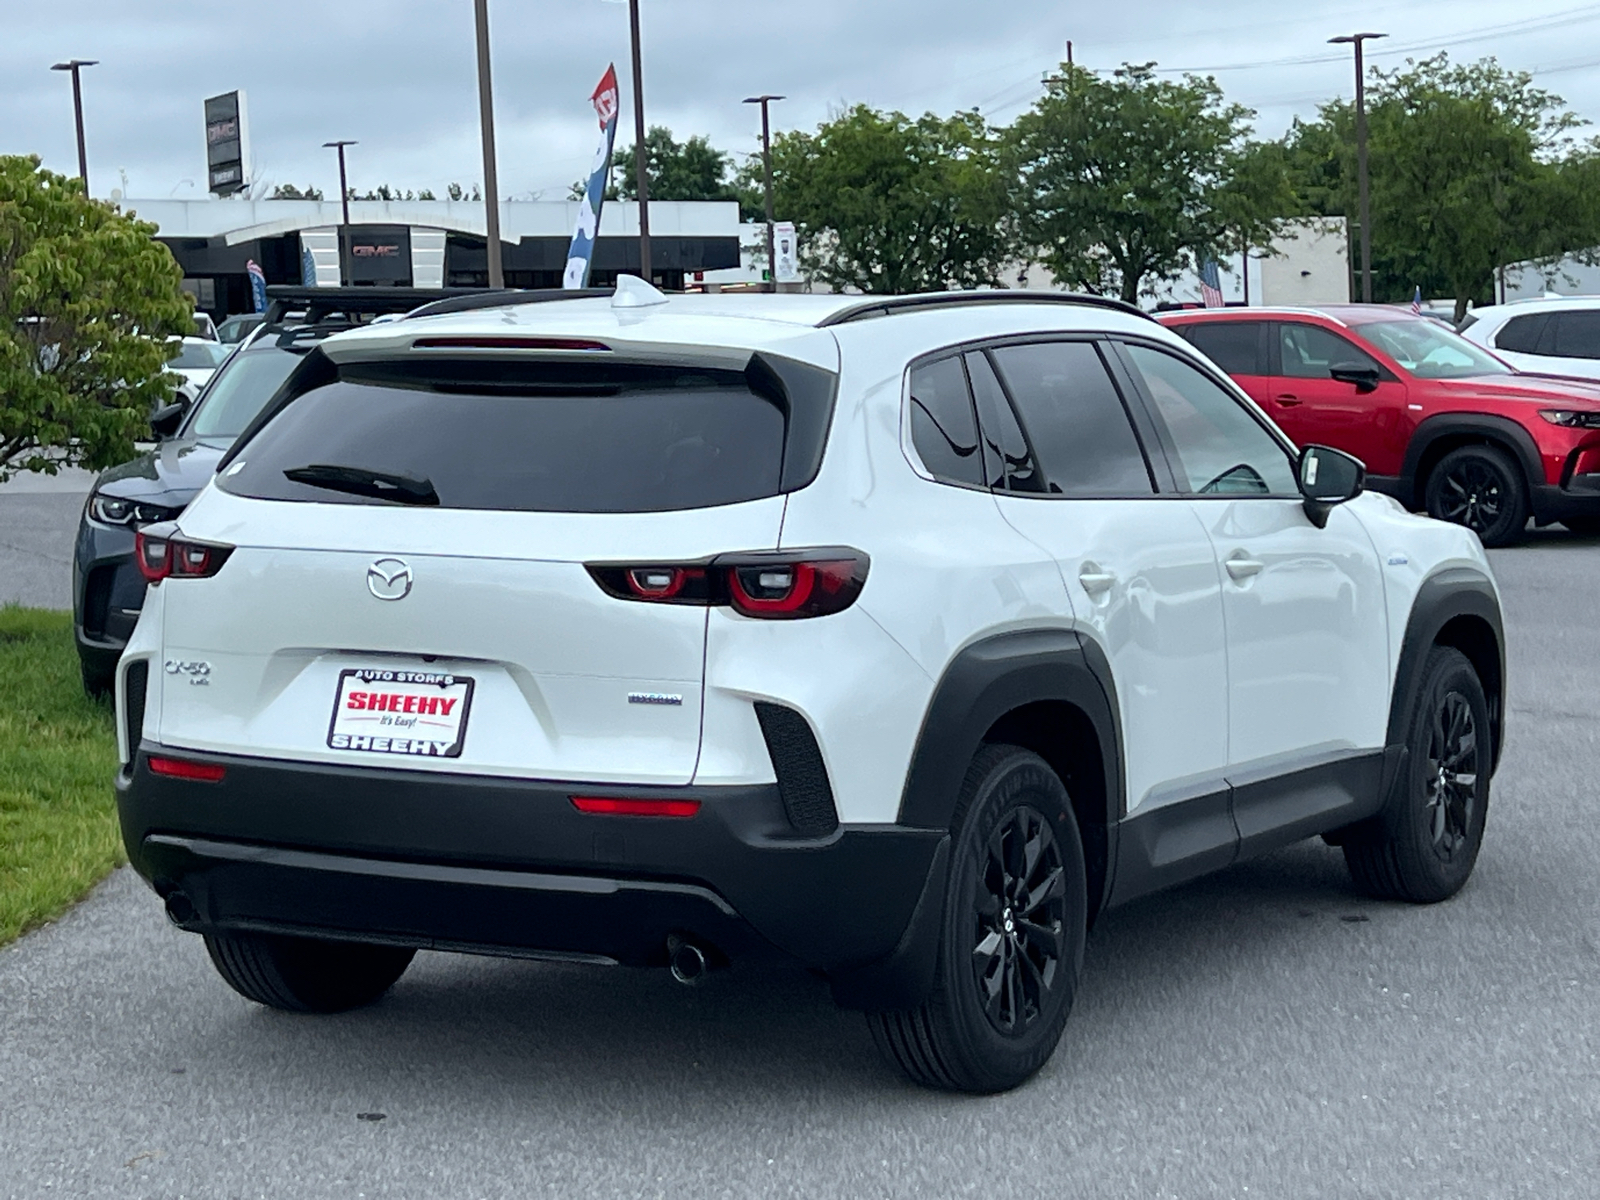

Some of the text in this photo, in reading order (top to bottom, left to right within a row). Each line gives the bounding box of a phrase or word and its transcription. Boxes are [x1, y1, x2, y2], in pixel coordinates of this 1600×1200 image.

[352, 245, 399, 257] GMC
[165, 659, 211, 675] CX-50
[355, 670, 454, 685] AUTO STORES
[347, 691, 458, 716] SHEEHY
[394, 716, 418, 729] Easy!
[331, 734, 456, 756] SHEEHY
